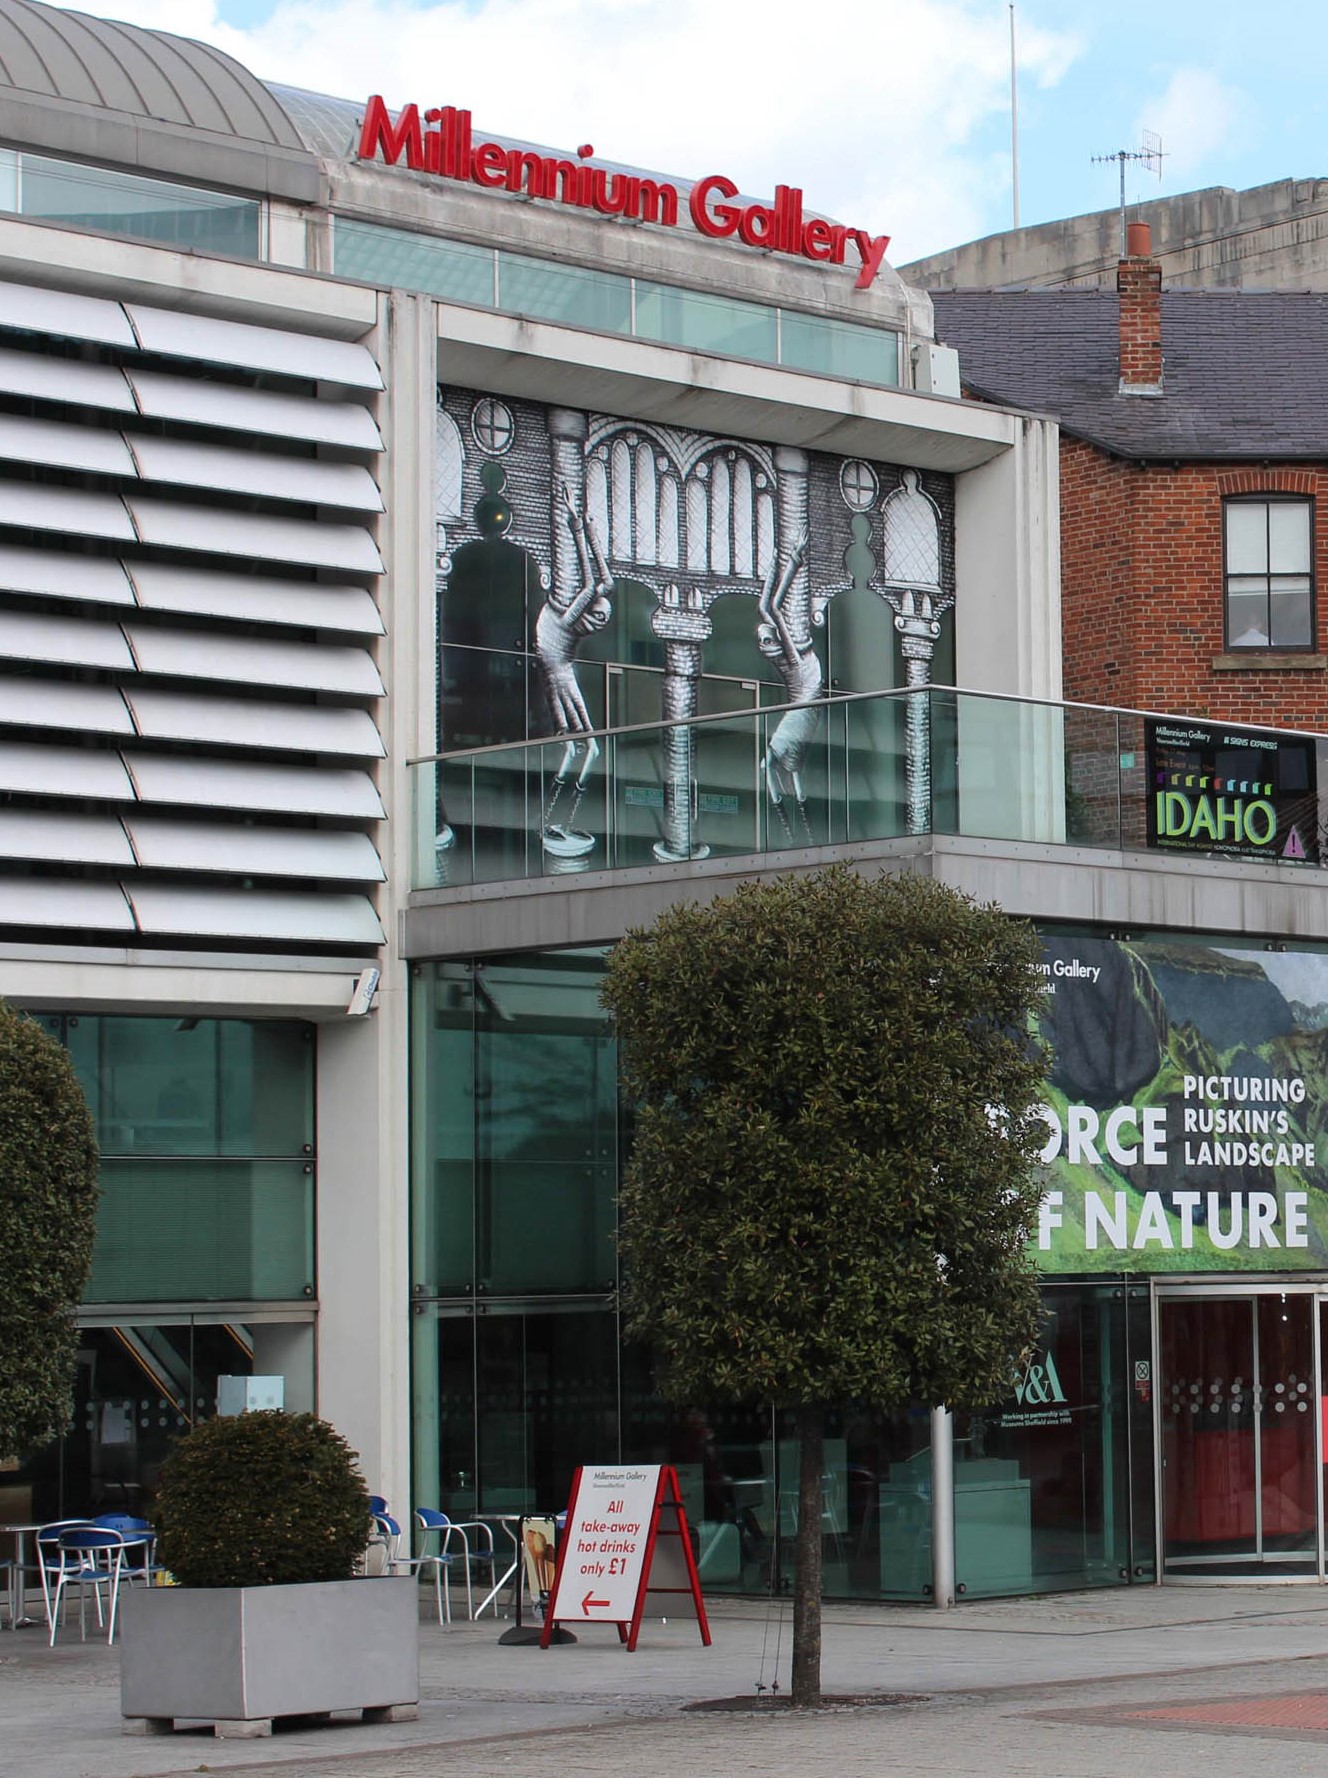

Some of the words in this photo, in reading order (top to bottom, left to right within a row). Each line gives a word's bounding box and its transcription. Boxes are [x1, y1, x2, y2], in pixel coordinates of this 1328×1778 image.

[358, 95, 679, 226] Millennium
[689, 175, 891, 289] Gallery
[1156, 726, 1188, 738] Millennium
[1188, 731, 1211, 743] Gallery
[1157, 789, 1277, 845] IDAHO
[1053, 959, 1101, 983] Gallery
[1183, 1075, 1306, 1103] PICTURING
[1184, 1108, 1289, 1135] RUSKIN'S
[985, 1104, 1168, 1167] ORCE
[1184, 1141, 1315, 1167] LANDSCAPE
[1084, 1191, 1309, 1250] NATURE
[592, 1471, 625, 1480] Millennium
[625, 1470, 648, 1483] Gallery
[607, 1500, 624, 1514] All
[581, 1519, 641, 1537] take-away
[577, 1539, 597, 1553] hot
[600, 1539, 636, 1554] drinks
[580, 1561, 605, 1578] only
[608, 1557, 627, 1575] £1
